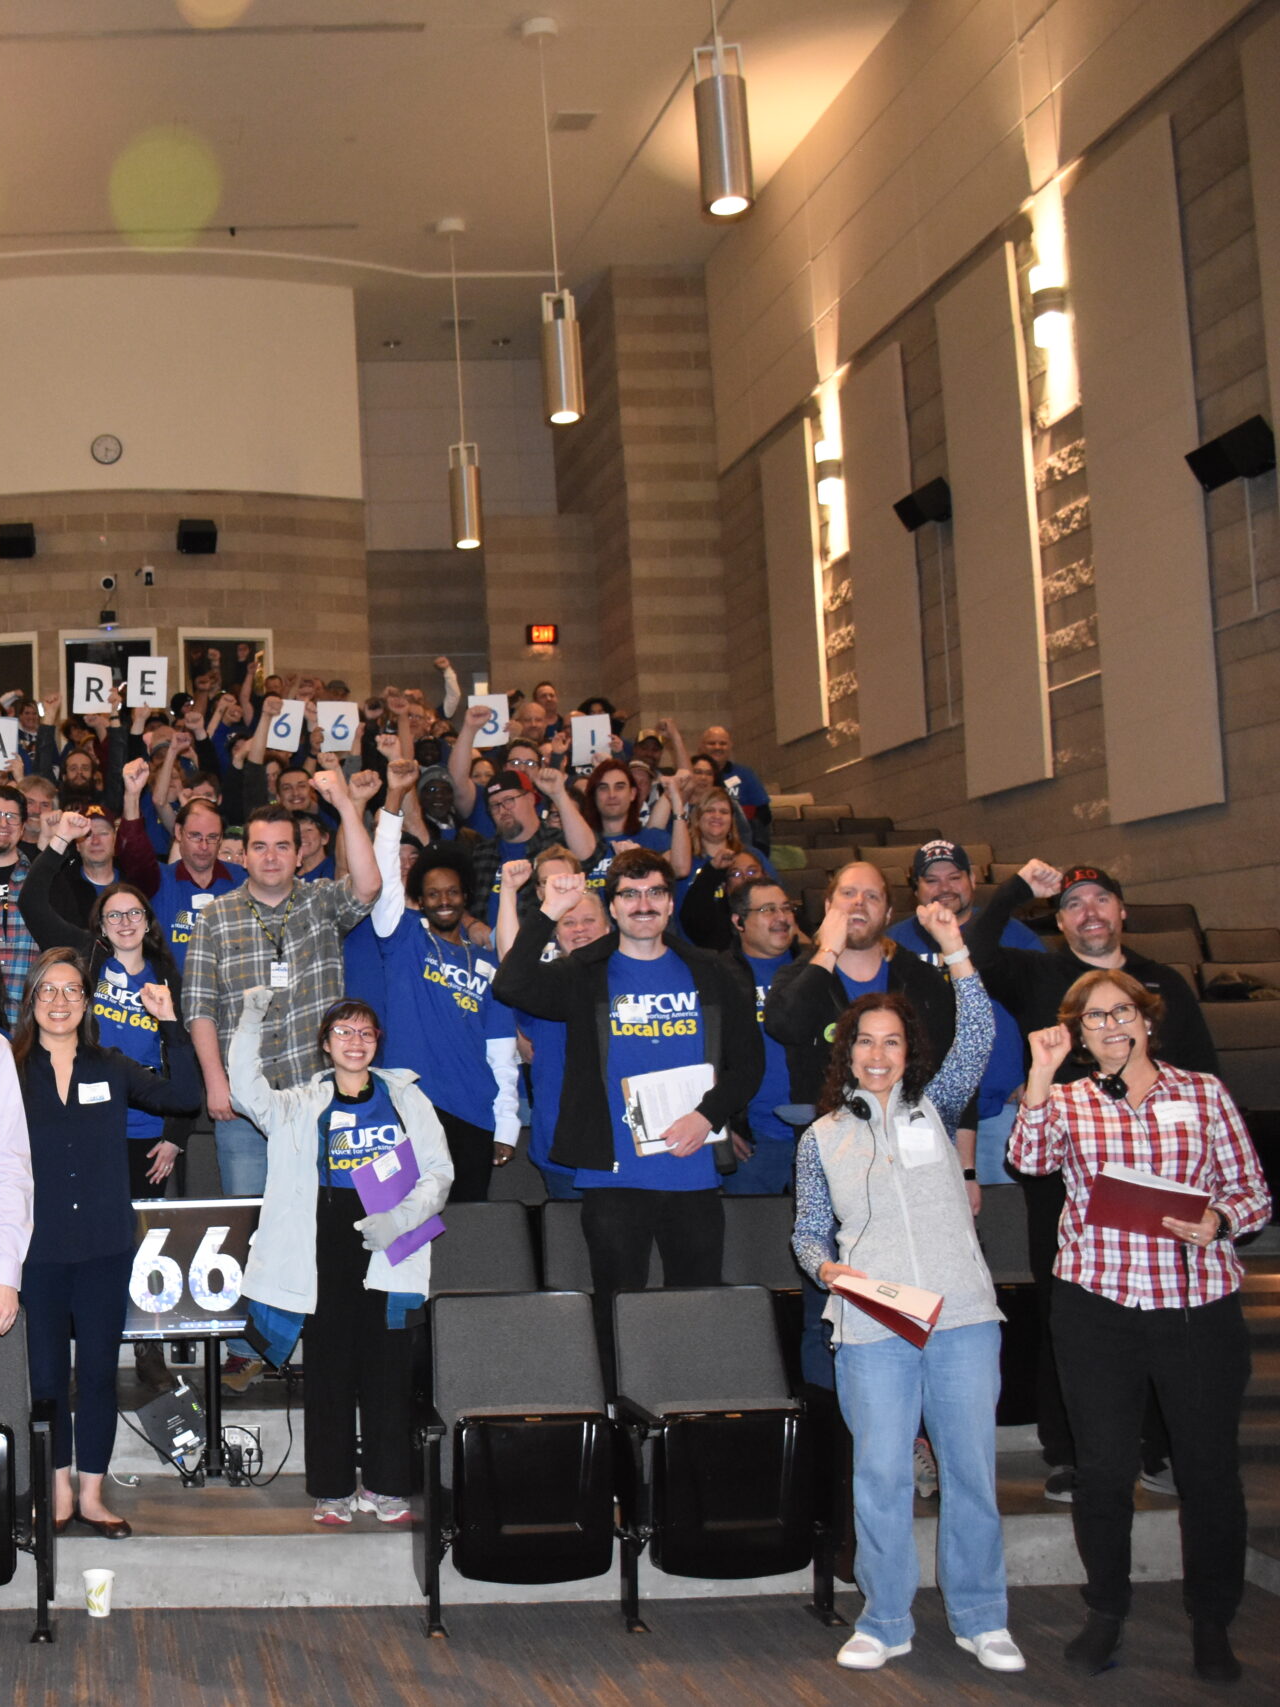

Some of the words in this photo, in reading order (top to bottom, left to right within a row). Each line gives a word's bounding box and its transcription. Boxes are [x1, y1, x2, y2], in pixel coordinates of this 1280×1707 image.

[85, 676, 105, 703] R
[140, 670, 157, 696] E
[273, 712, 291, 738] 6
[331, 714, 350, 740] 6
[107, 983, 144, 1007] UFC
[93, 1003, 128, 1023] ocal
[129, 1013, 159, 1032] 663
[610, 1019, 660, 1037] Local
[661, 1018, 697, 1037] 663
[128, 1226, 250, 1313] 66
